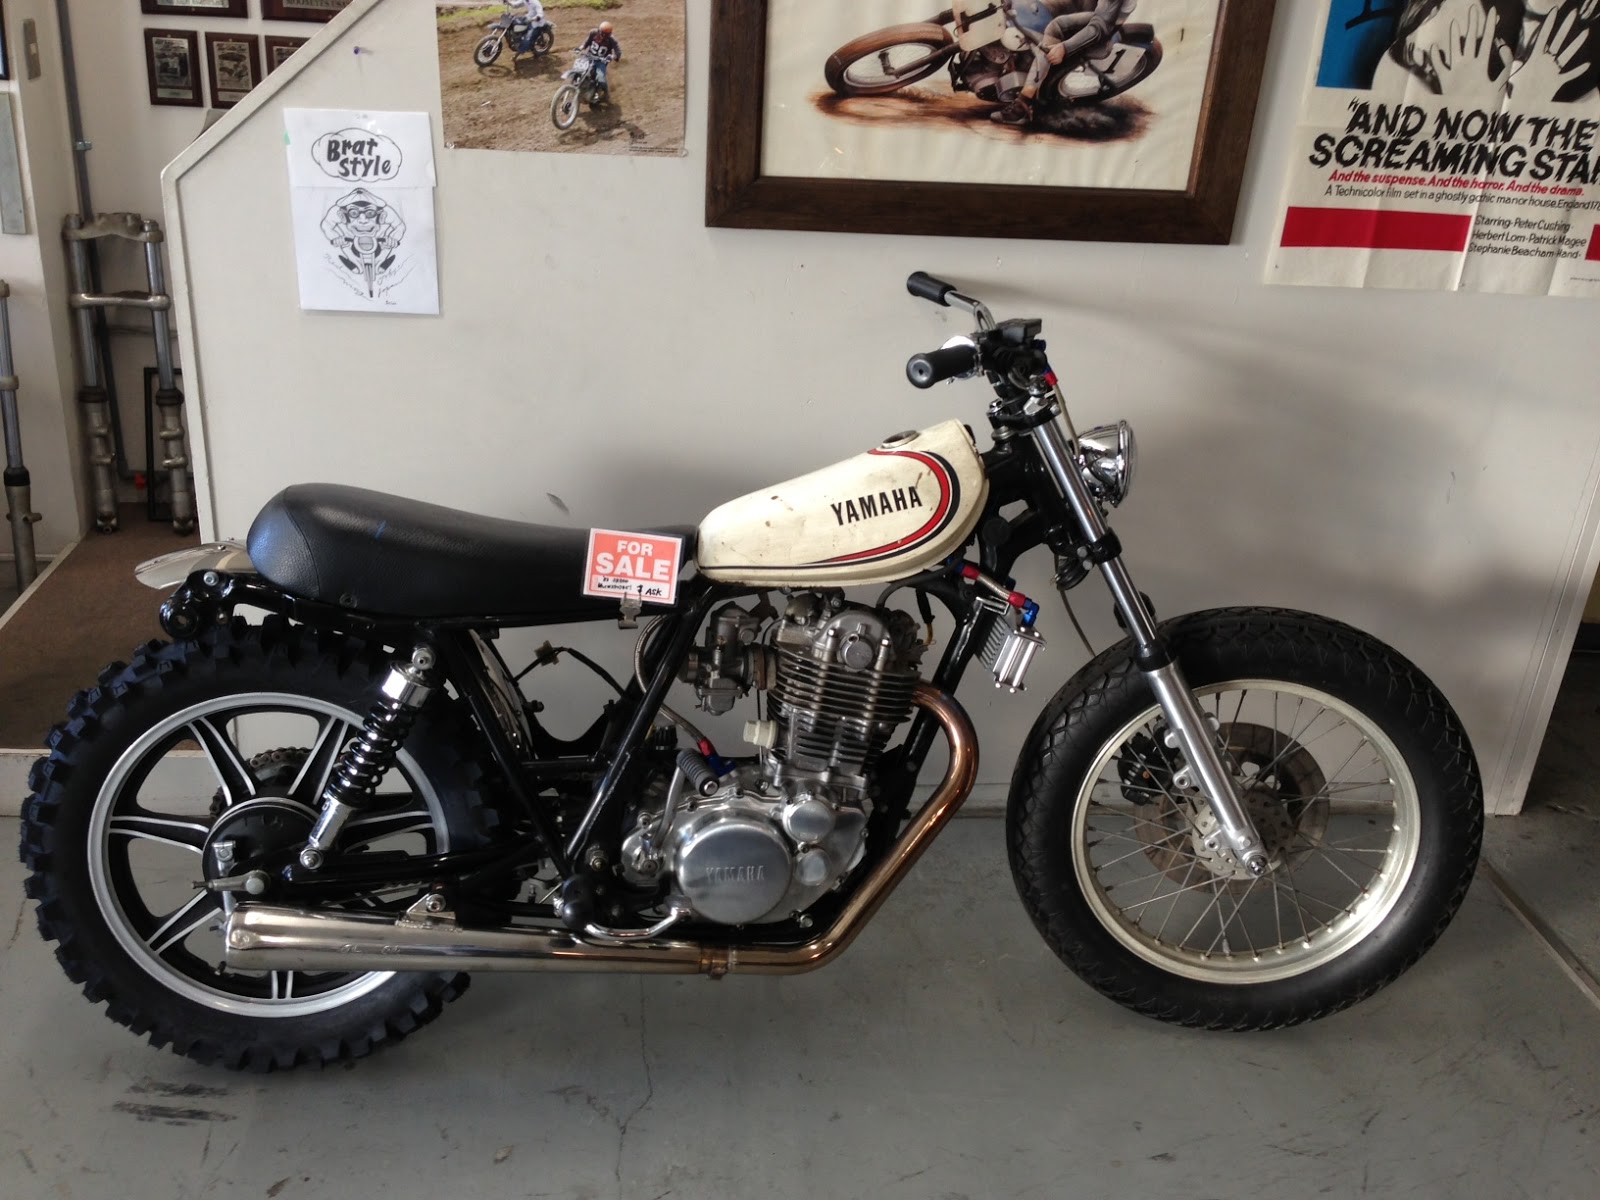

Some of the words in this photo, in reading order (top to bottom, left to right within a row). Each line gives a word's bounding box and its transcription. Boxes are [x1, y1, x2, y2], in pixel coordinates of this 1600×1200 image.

[1432, 106, 1524, 144] NOW
[1526, 116, 1600, 153] THE
[327, 137, 379, 162] Brat
[1309, 133, 1528, 178] SCREAMING
[1328, 169, 1354, 183] And
[1353, 171, 1371, 183] the
[1371, 173, 1428, 187] suspense.
[1428, 175, 1455, 188] And
[1451, 177, 1471, 189] the
[1469, 178, 1505, 192] horror.
[1506, 180, 1532, 193] And
[1529, 182, 1548, 195] the
[1324, 184, 1333, 196] A
[1335, 184, 1386, 198] Technicolor
[1385, 187, 1402, 199] film
[1404, 189, 1420, 200] set
[1420, 189, 1429, 199] in
[1434, 190, 1469, 204] ghostly
[1468, 193, 1496, 205] gothic
[1496, 196, 1529, 207] manor
[1513, 217, 1537, 229] Peter
[1537, 219, 1571, 234] Cushing
[1468, 241, 1511, 255] Stephanie
[1511, 245, 1555, 258] Beacham
[1472, 228, 1506, 241] Herbert
[1528, 232, 1559, 246] Patrick
[1558, 235, 1587, 249] Magee
[830, 485, 923, 526] YAMAHA
[616, 540, 654, 557] FOR
[595, 551, 672, 581] SALE
[705, 864, 765, 883] YAMAHA
